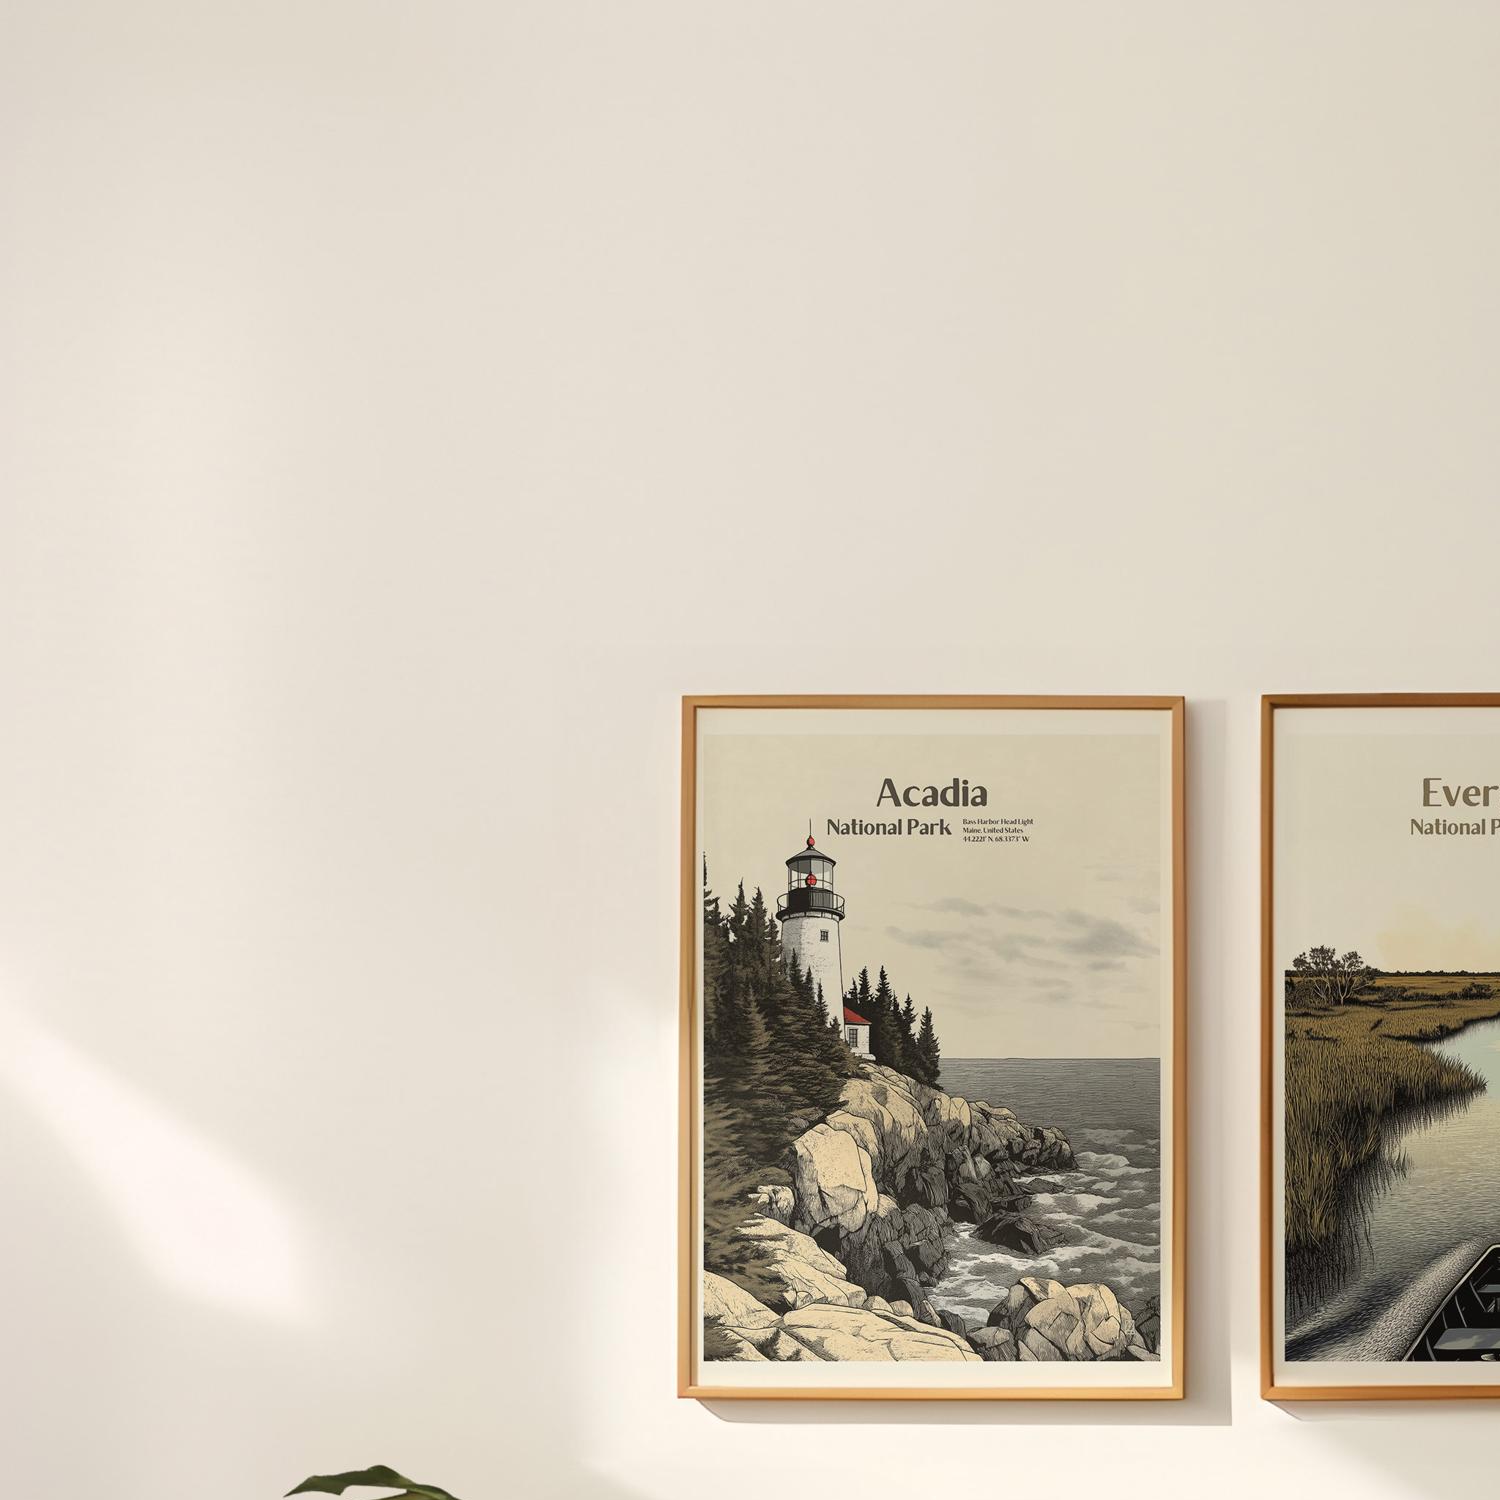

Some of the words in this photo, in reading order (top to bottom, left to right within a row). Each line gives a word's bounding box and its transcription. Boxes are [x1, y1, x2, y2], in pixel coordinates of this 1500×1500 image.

[876, 778, 987, 807] Acadia
[827, 819, 902, 835] National
[908, 819, 952, 835] Park
[1411, 819, 1485, 835] National
